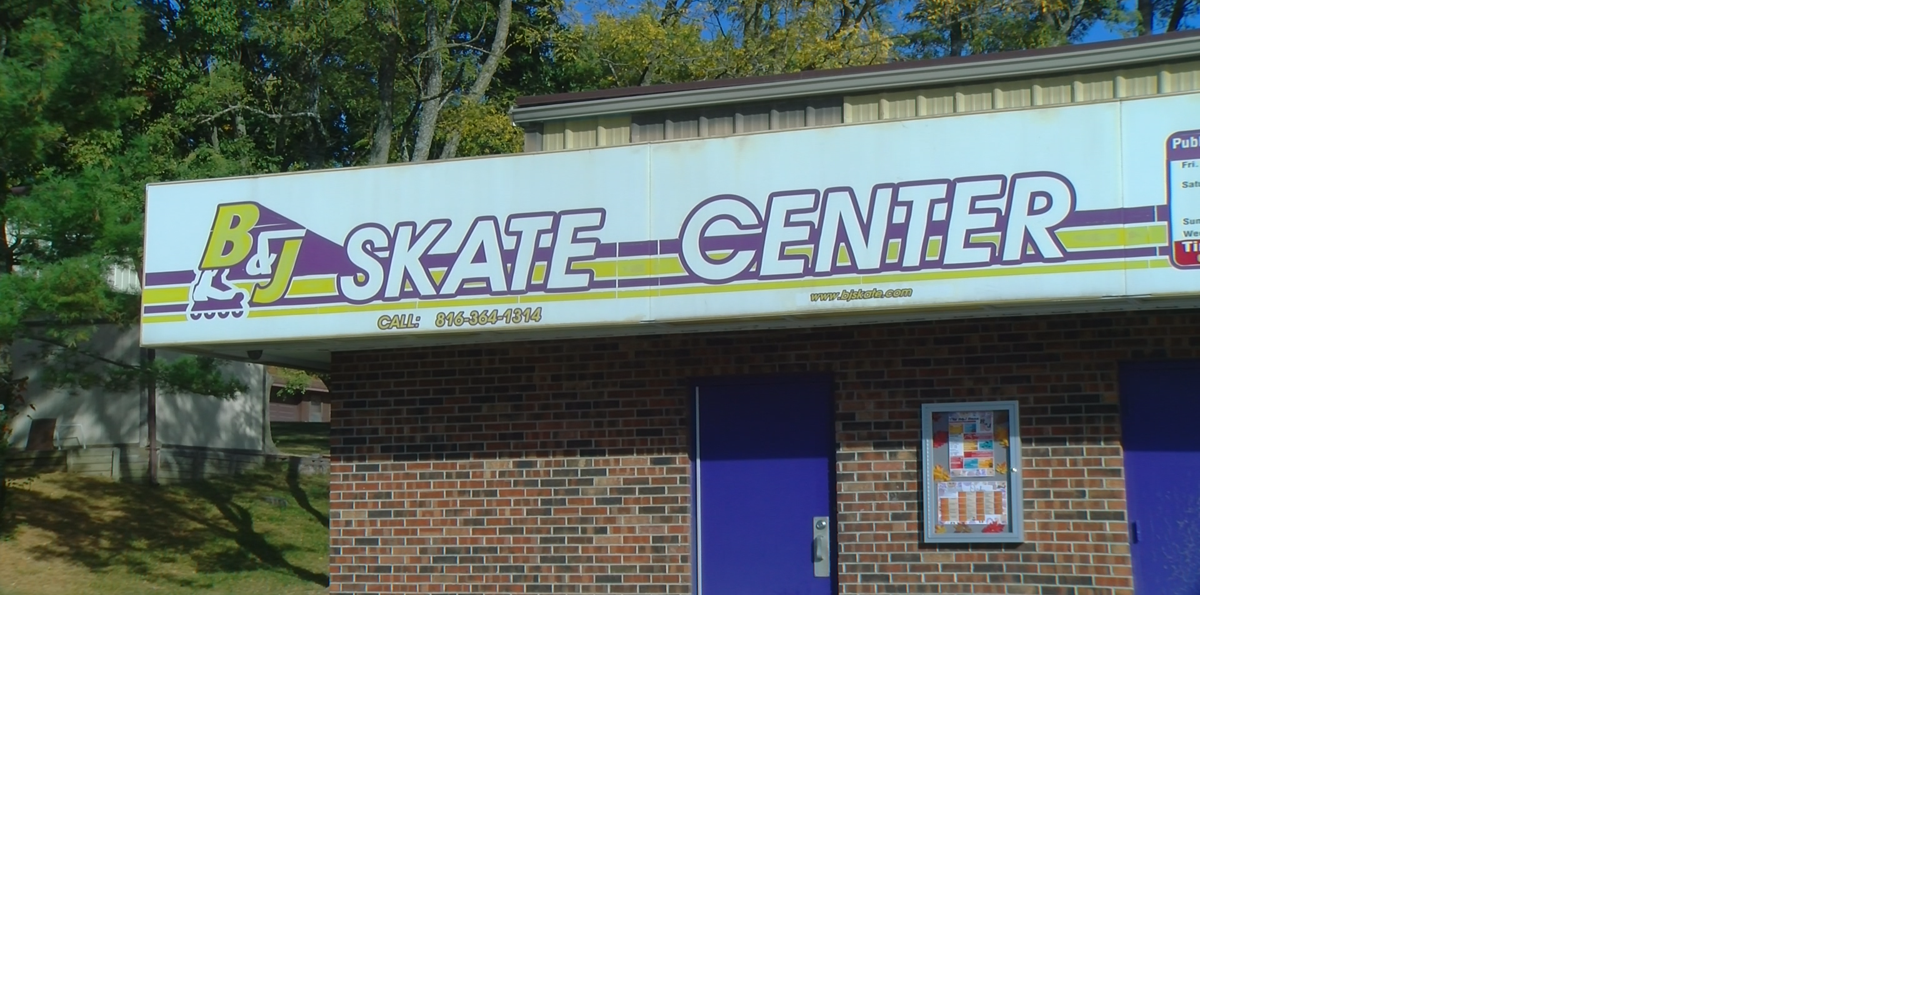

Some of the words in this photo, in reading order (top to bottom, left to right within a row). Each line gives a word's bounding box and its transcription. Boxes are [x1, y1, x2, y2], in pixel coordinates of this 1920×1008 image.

[199, 201, 306, 304] B&J
[338, 208, 606, 303] SKATE
[679, 172, 1075, 284] CENTER
[810, 288, 913, 302] www.bjskate.com
[377, 314, 421, 329] CALL:
[435, 307, 542, 327] 816-364-1314
